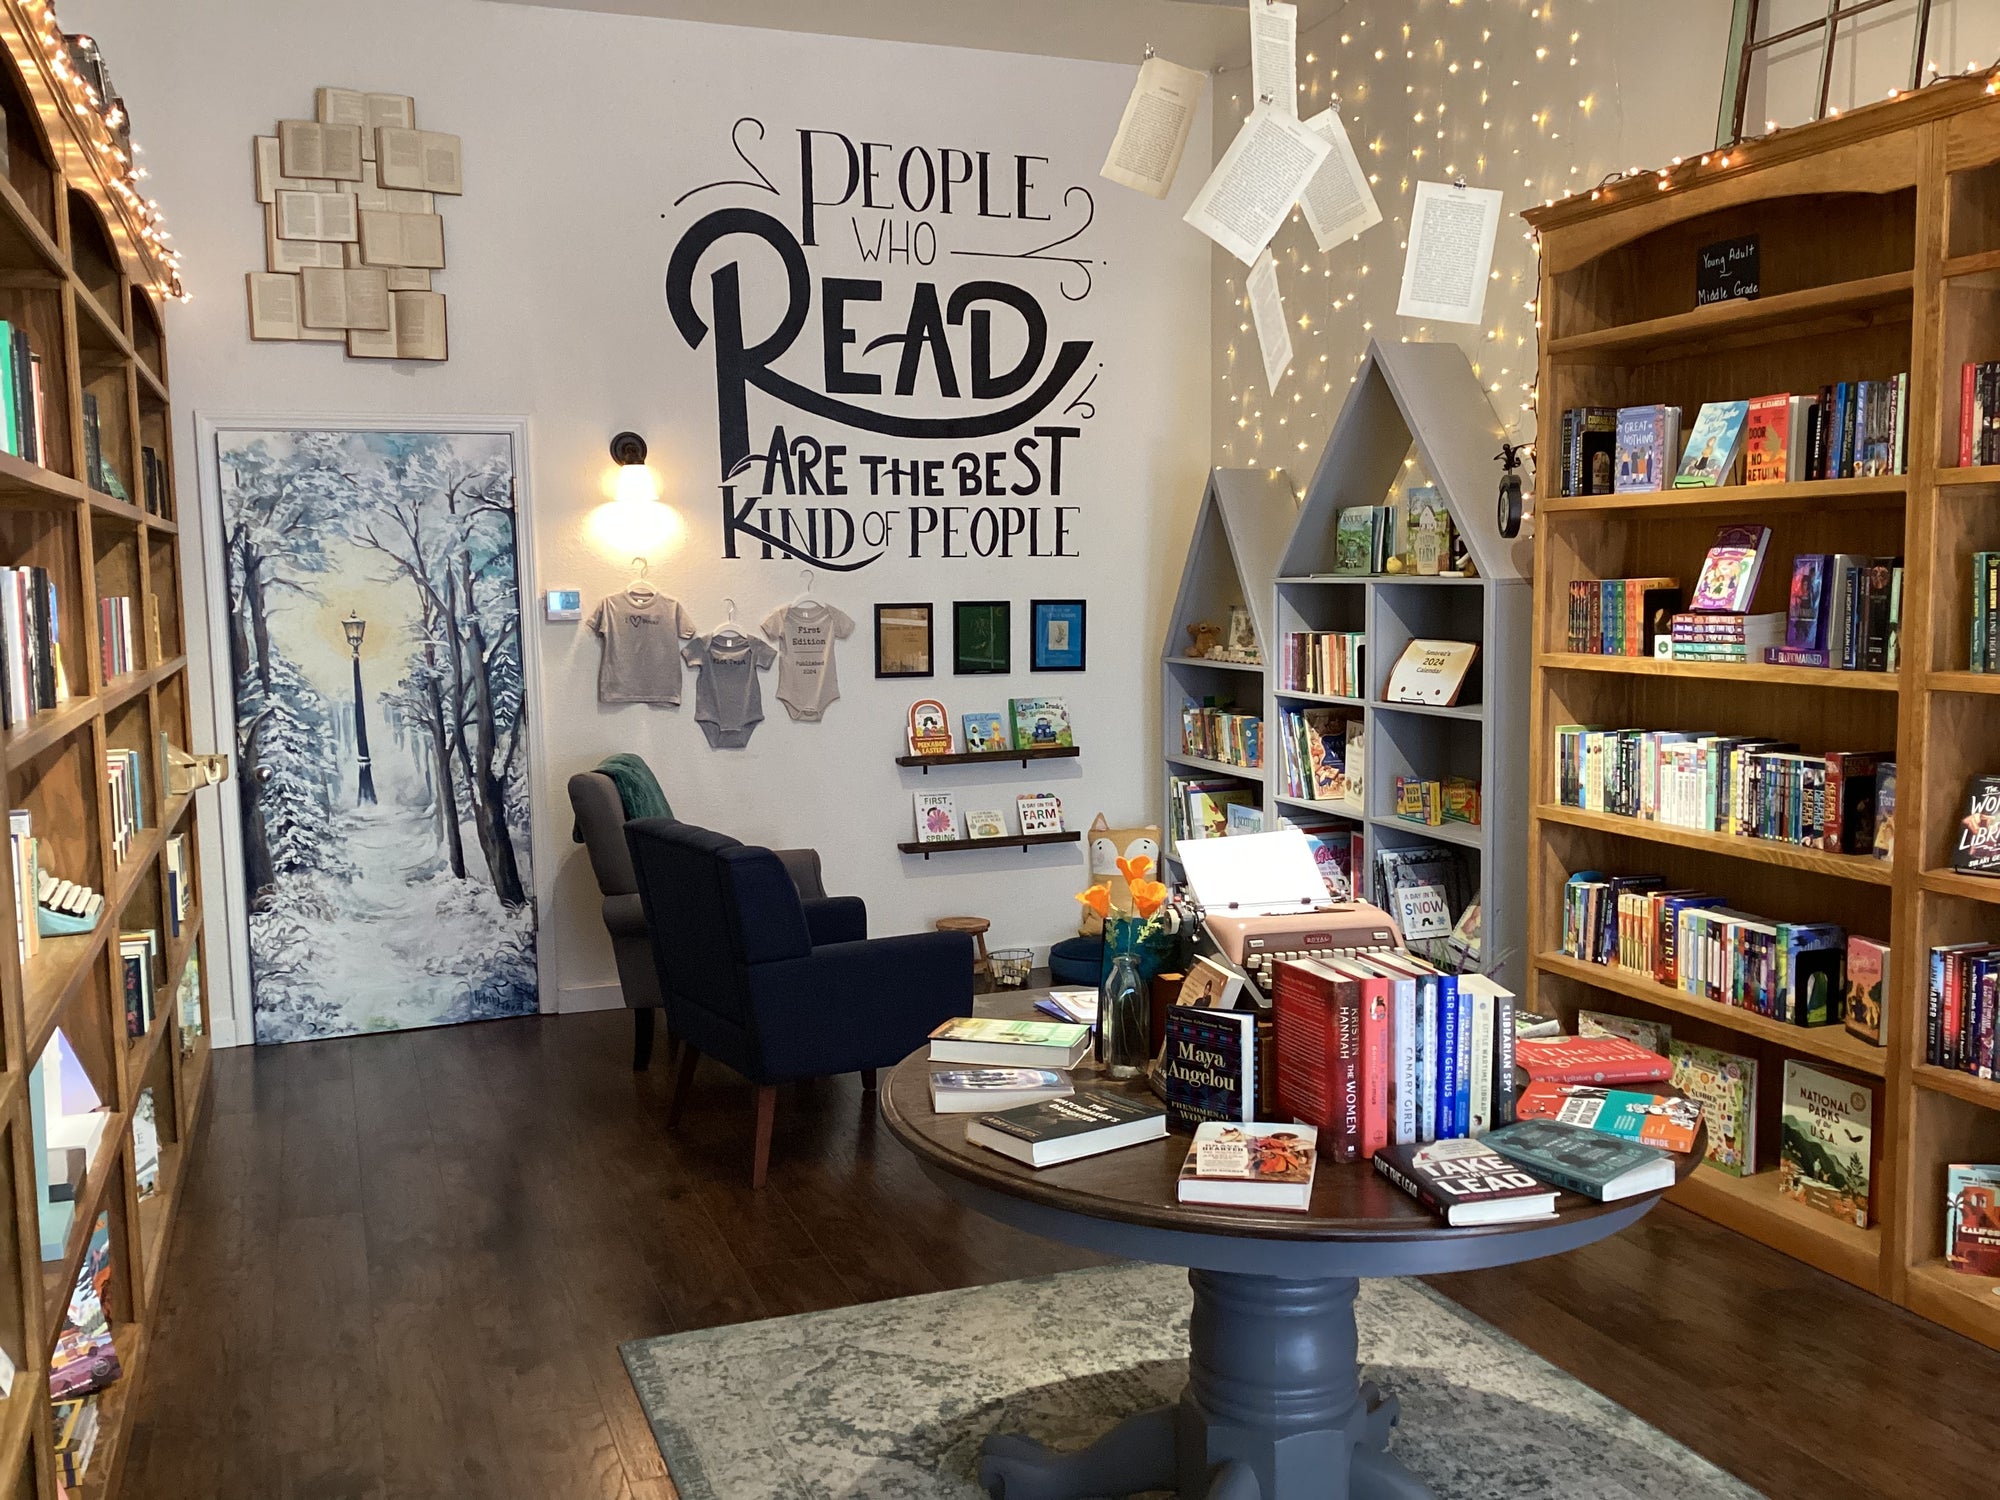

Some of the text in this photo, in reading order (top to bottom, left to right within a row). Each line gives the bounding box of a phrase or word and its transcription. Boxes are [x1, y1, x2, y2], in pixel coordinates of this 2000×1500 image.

[796, 128, 1051, 246] PEOPLE
[852, 216, 936, 266] WHO
[1703, 244, 1755, 273] Young Adult
[1698, 280, 1758, 307] Middle Grade
[666, 208, 1094, 482] READ
[1624, 420, 1647, 431] GREAT
[1749, 427, 1766, 439] DOOR
[1753, 416, 1761, 424] THE
[1623, 432, 1655, 445] NOTHING
[728, 425, 1081, 497] ARE THE BEST
[1751, 453, 1762, 466] NO
[718, 485, 1081, 572] KIND OF PEOPLE
[792, 638, 826, 646] Edition
[797, 626, 821, 634] First
[1423, 658, 1445, 666] 2024
[1023, 809, 1057, 821] FARM
[1405, 901, 1444, 916] SNOW
[1665, 907, 1674, 975] BIG TREE
[1929, 986, 1938, 1018] HARPER
[1340, 1006, 1350, 1059] HANNAH
[1351, 1008, 1360, 1056] KRISTIN
[1445, 1012, 1454, 1050] HIDDEN
[1503, 1011, 1511, 1068] LIBRARIAN
[1178, 1041, 1226, 1069] Maya
[1528, 1054, 1652, 1068] Agitators
[1541, 1048, 1591, 1057] The
[1168, 1060, 1235, 1091] Angelou
[1444, 1058, 1453, 1097] GENIUS
[1503, 1073, 1511, 1093] SPY
[1088, 1103, 1108, 1112] THE
[1172, 1101, 1231, 1121] PHENOMENAL
[1346, 1064, 1357, 1134] THE WOMEN
[1800, 1087, 1850, 1116] NATIONAL
[1404, 1098, 1413, 1135] GIRLS
[1808, 1102, 1840, 1124] PARKS
[1810, 1125, 1838, 1146] U.S.A.
[1374, 1154, 1418, 1198] TAKE THE LEAD
[1419, 1156, 1514, 1177] TAKE
[1437, 1173, 1538, 1195] LEAD
